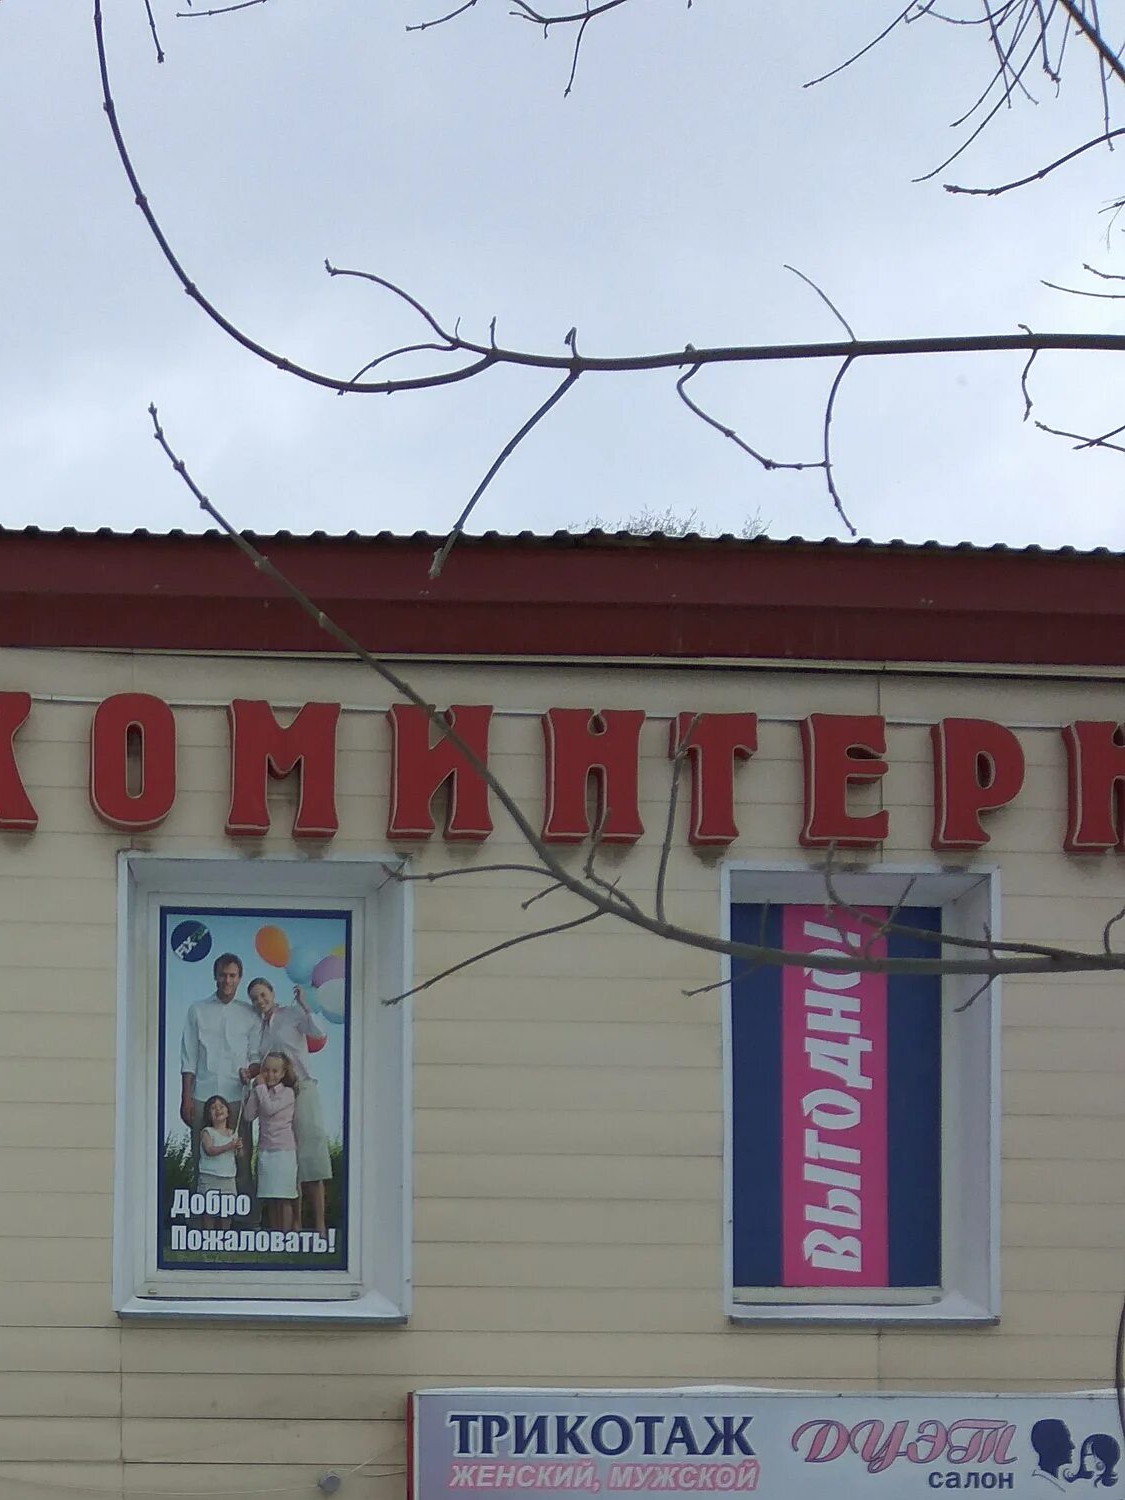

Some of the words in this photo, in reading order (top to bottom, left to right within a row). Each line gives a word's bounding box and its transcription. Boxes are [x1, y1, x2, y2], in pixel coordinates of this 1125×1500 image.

[802, 920, 873, 1274] ВЫГОДНО!
[170, 1189, 251, 1218] Добро
[171, 1225, 336, 1253] Пожаловать!
[449, 1414, 756, 1457] ТРИКОТАЖ
[791, 1419, 1018, 1474] ДУЭТ
[448, 1461, 601, 1492] ЖЕНСКИЙ,
[607, 1460, 759, 1491] МУЖСКОЙ
[928, 1470, 1014, 1489] салон
